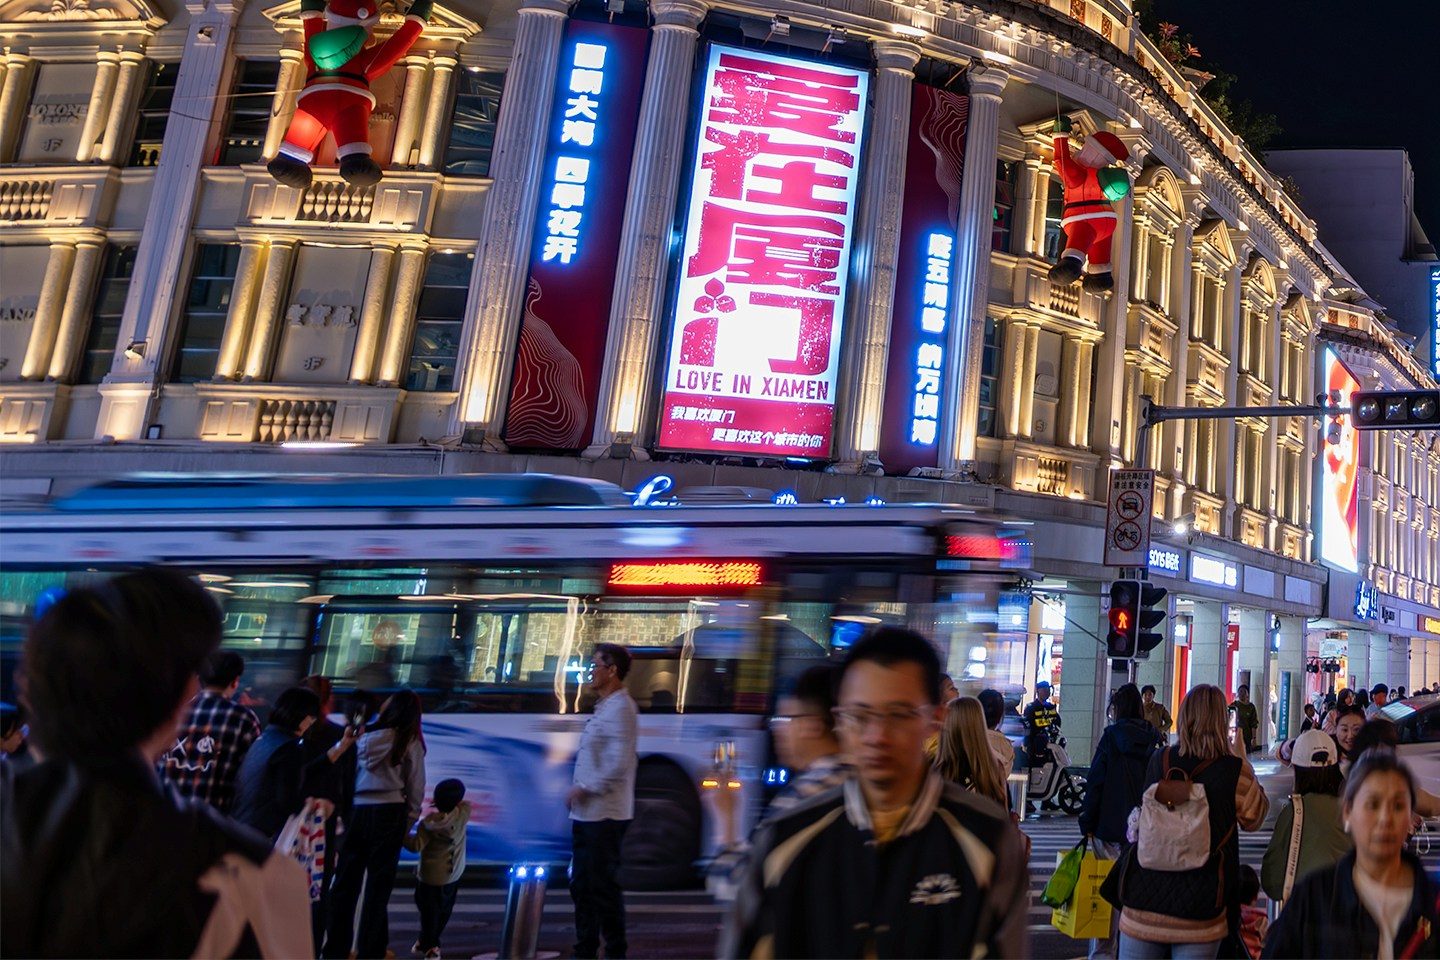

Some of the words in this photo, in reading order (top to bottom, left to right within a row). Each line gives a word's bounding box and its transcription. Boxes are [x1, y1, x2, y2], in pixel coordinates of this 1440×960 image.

[679, 53, 861, 376] 爱在厦门
[675, 369, 723, 392] LOVE
[732, 374, 751, 394] IN
[761, 376, 829, 401] XIAMEN
[671, 406, 736, 424] 我喜欢厦门
[711, 428, 824, 448] 更喜欢这个城市的你
